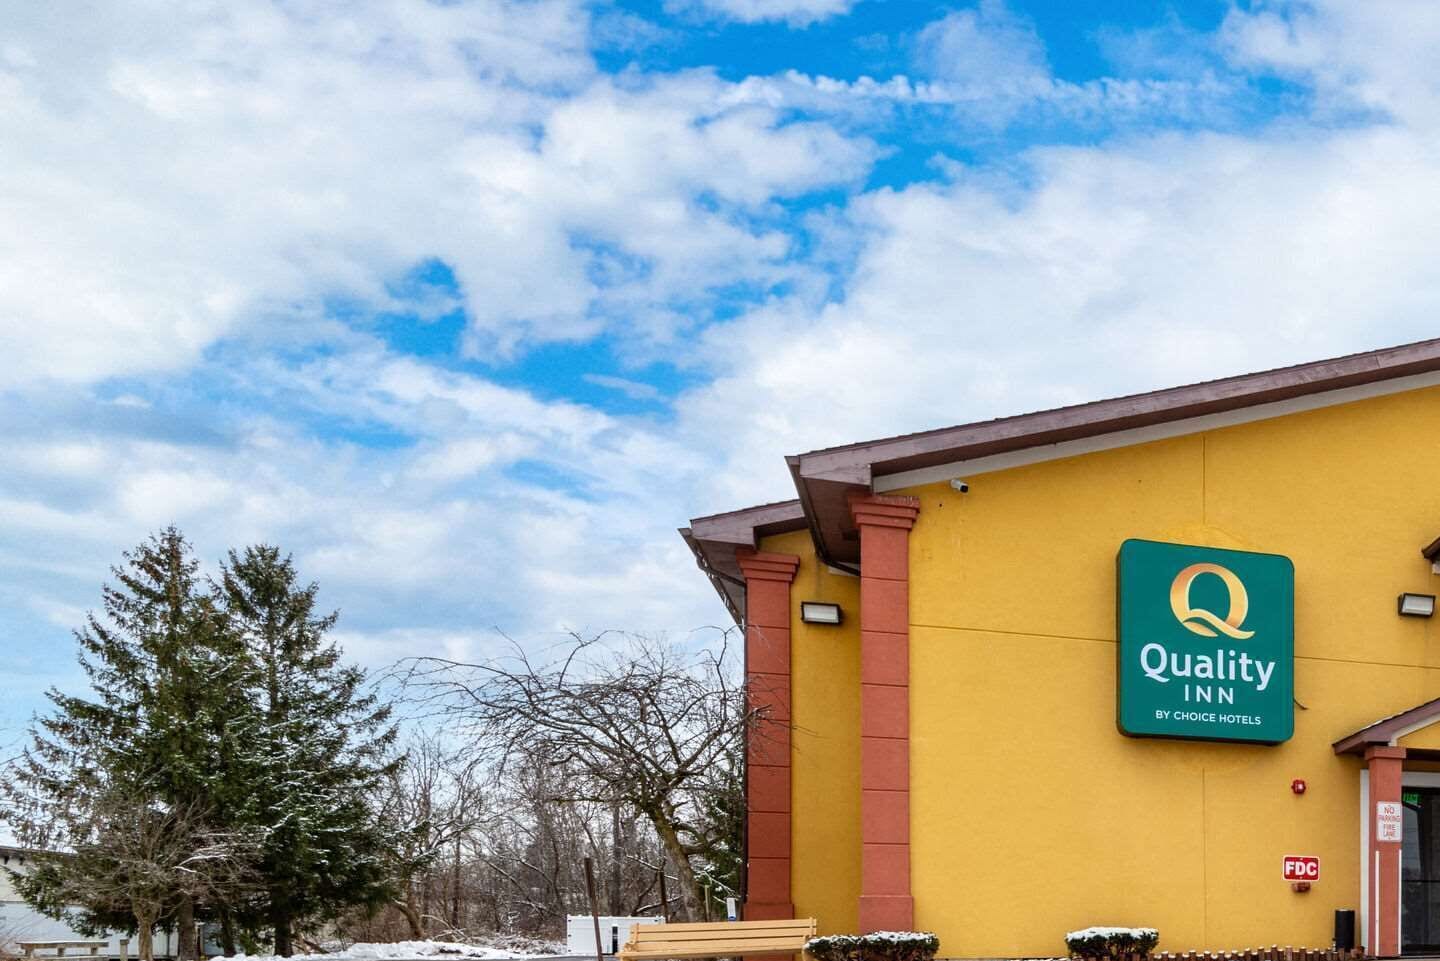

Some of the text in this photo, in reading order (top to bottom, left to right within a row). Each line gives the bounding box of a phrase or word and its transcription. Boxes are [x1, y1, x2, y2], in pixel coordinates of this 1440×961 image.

[1170, 563, 1255, 639] Q
[1140, 643, 1275, 691] Quality
[1184, 684, 1234, 704] INN
[1155, 710, 1262, 725] BY CHOICE HOTELS
[1378, 814, 1401, 822] PARKING
[1383, 806, 1395, 815] NO
[1383, 823, 1396, 831] FIRE
[1285, 861, 1318, 876] FDC
